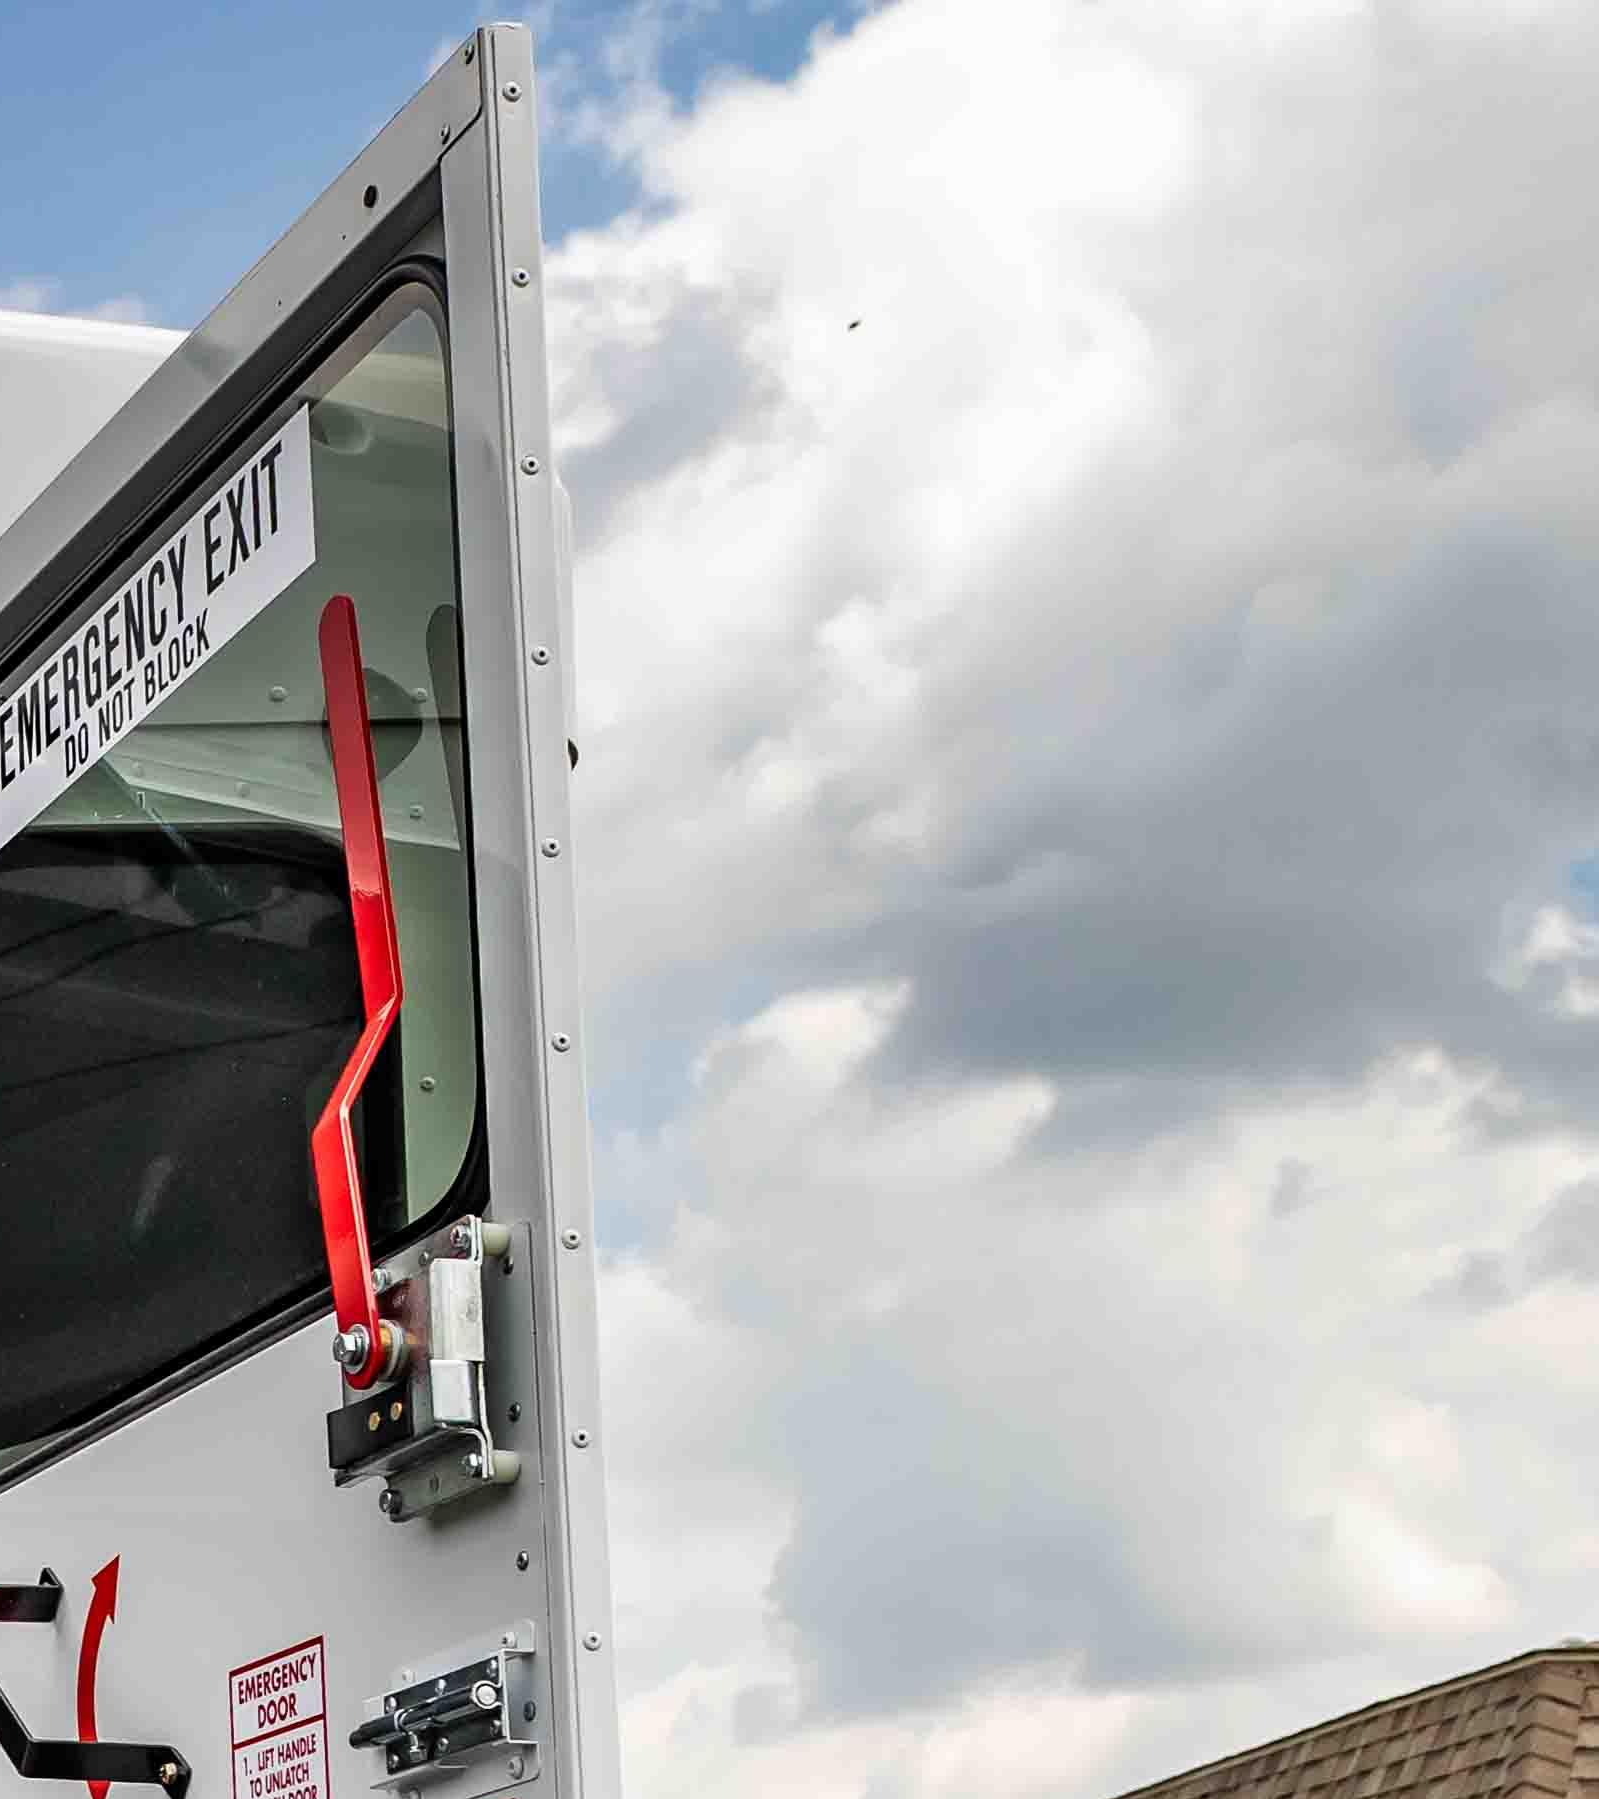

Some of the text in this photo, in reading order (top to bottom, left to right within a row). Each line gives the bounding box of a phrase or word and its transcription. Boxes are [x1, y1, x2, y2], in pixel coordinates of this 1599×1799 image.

[203, 440, 283, 596] EXIT
[64, 608, 210, 779] DO NOT BLOCK
[238, 1652, 316, 1705] EMERGENCY
[257, 1692, 298, 1729] DOOR
[243, 1733, 316, 1776] 1. LIFT HANDLE
[250, 1760, 310, 1799] TO UNLATCH
